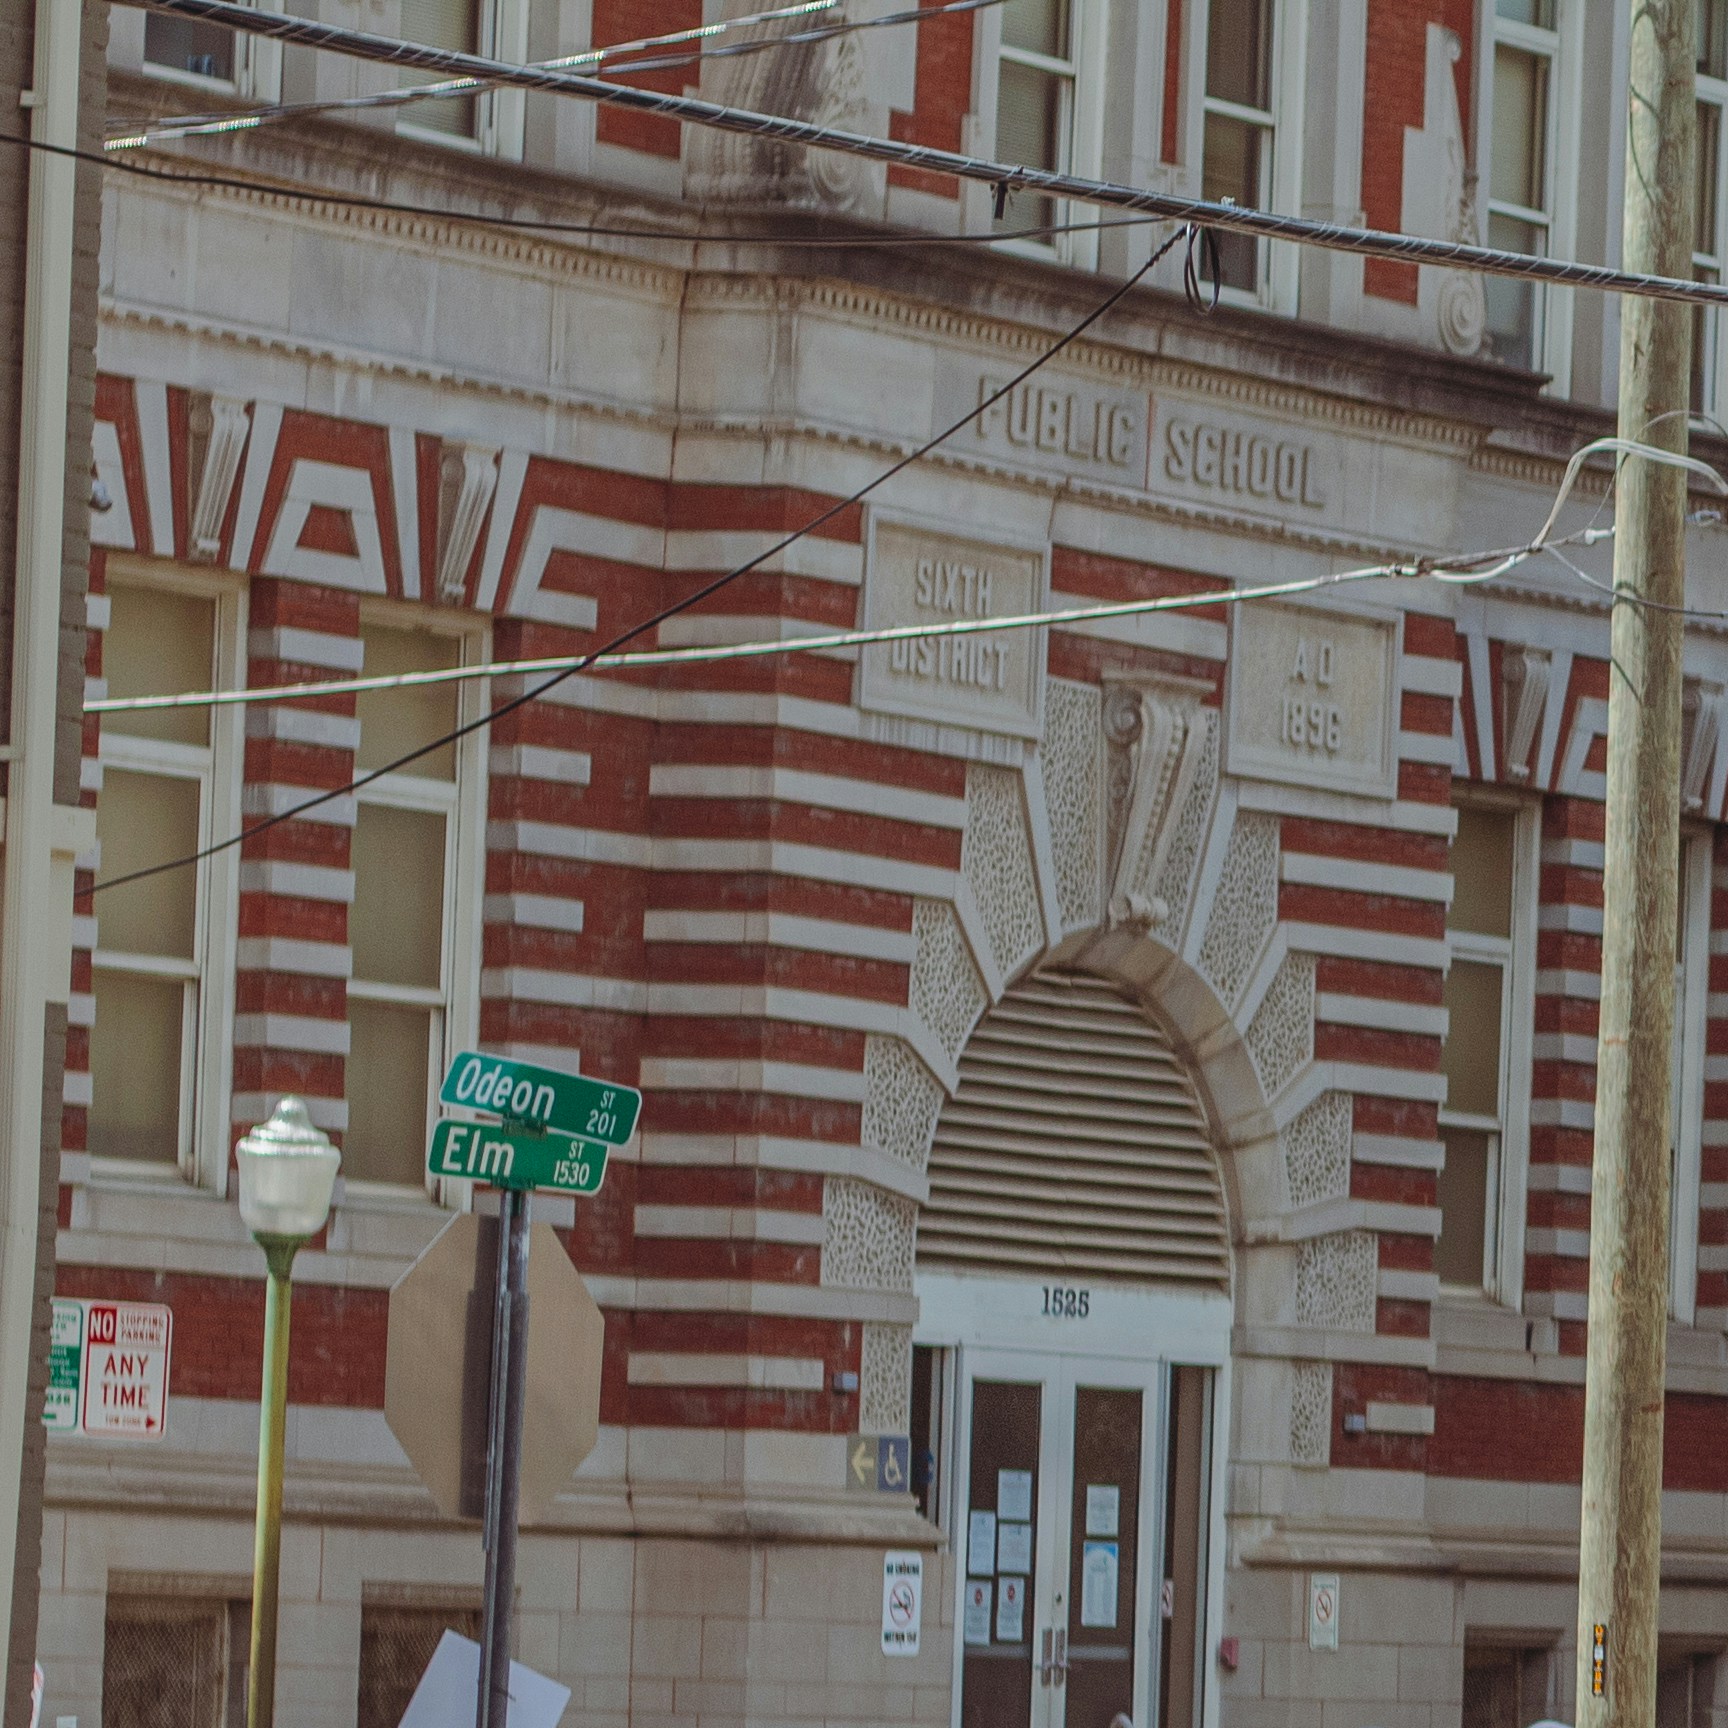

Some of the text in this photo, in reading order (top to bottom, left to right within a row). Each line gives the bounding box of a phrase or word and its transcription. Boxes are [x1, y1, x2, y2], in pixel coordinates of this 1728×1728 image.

[976, 372, 1327, 510] PUBLIC SCHOOL
[914, 557, 994, 620] SIXTH
[888, 626, 1010, 692] DISTRICT
[1279, 694, 1341, 757] 1896
[455, 1057, 556, 1121] Odeon
[600, 1090, 616, 1109] ST
[586, 1108, 617, 1138] 201
[441, 1125, 515, 1178] Elm
[568, 1140, 585, 1160] ST
[553, 1160, 590, 1187] 1530
[1041, 1286, 1090, 1318] 1525
[89, 1309, 115, 1342] NO
[104, 1350, 149, 1378] ANY
[101, 1381, 151, 1410] TIME
